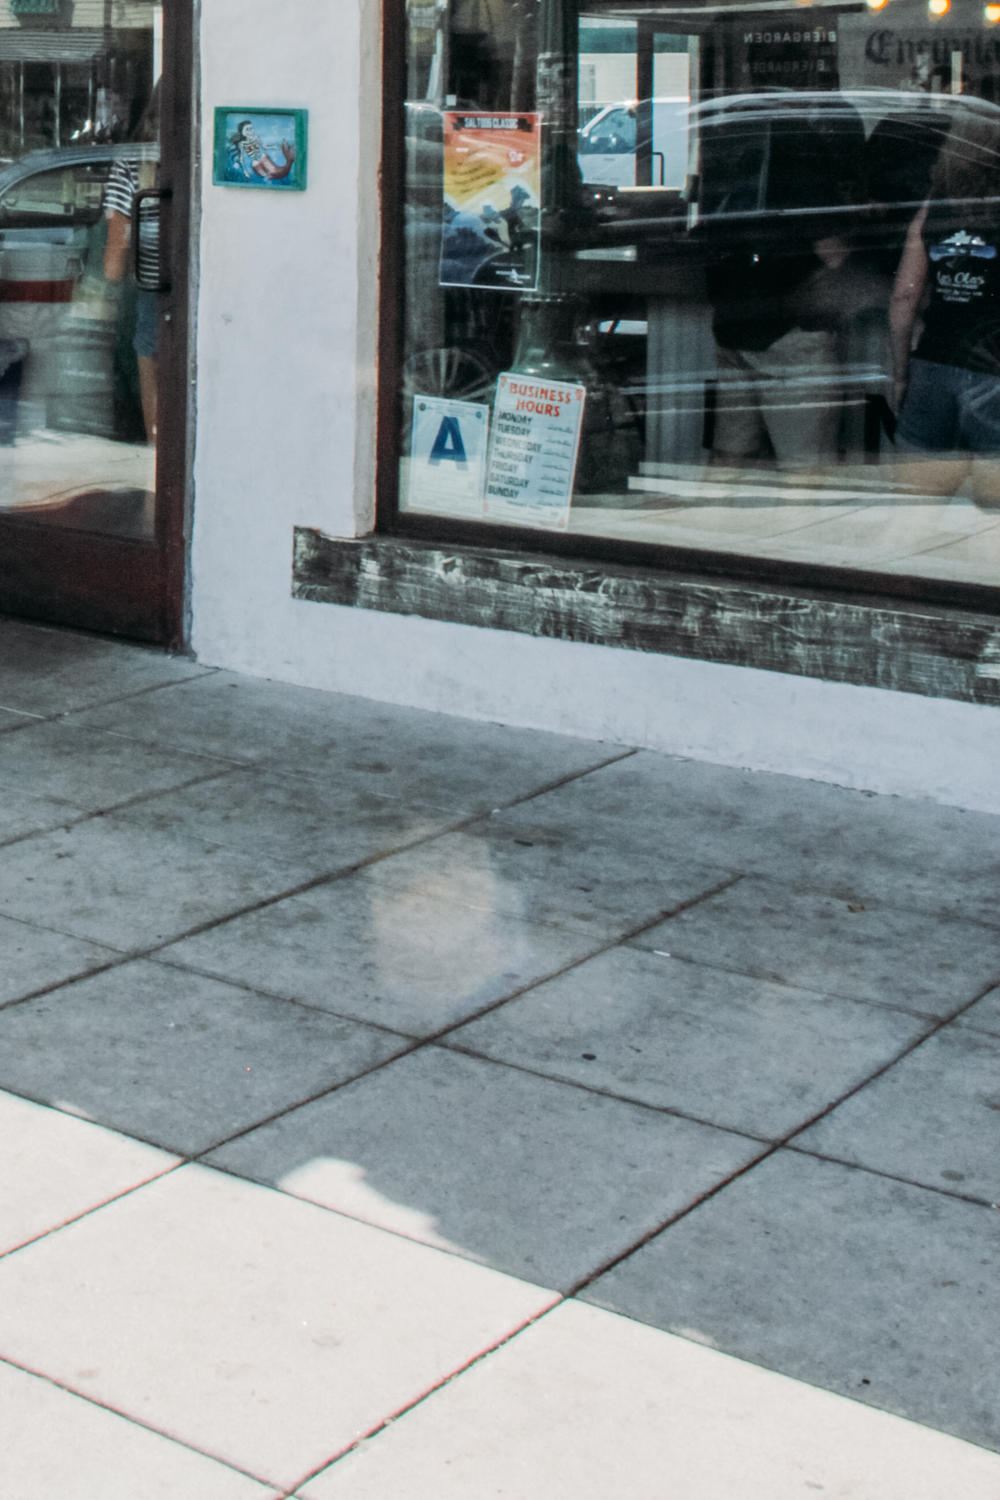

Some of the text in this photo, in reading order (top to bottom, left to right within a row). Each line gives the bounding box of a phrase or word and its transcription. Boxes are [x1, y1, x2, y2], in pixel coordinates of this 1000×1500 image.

[516, 399, 560, 418] HOURS
[498, 411, 533, 425] MONDAY
[497, 423, 532, 436] TUESDAY
[428, 415, 470, 472] A
[495, 436, 543, 452] WEDNESDAY
[493, 448, 534, 464] THURSDAY
[491, 460, 519, 473] FRIDAY
[489, 472, 530, 488] SATURDAY
[487, 484, 520, 499] SUNDAY
